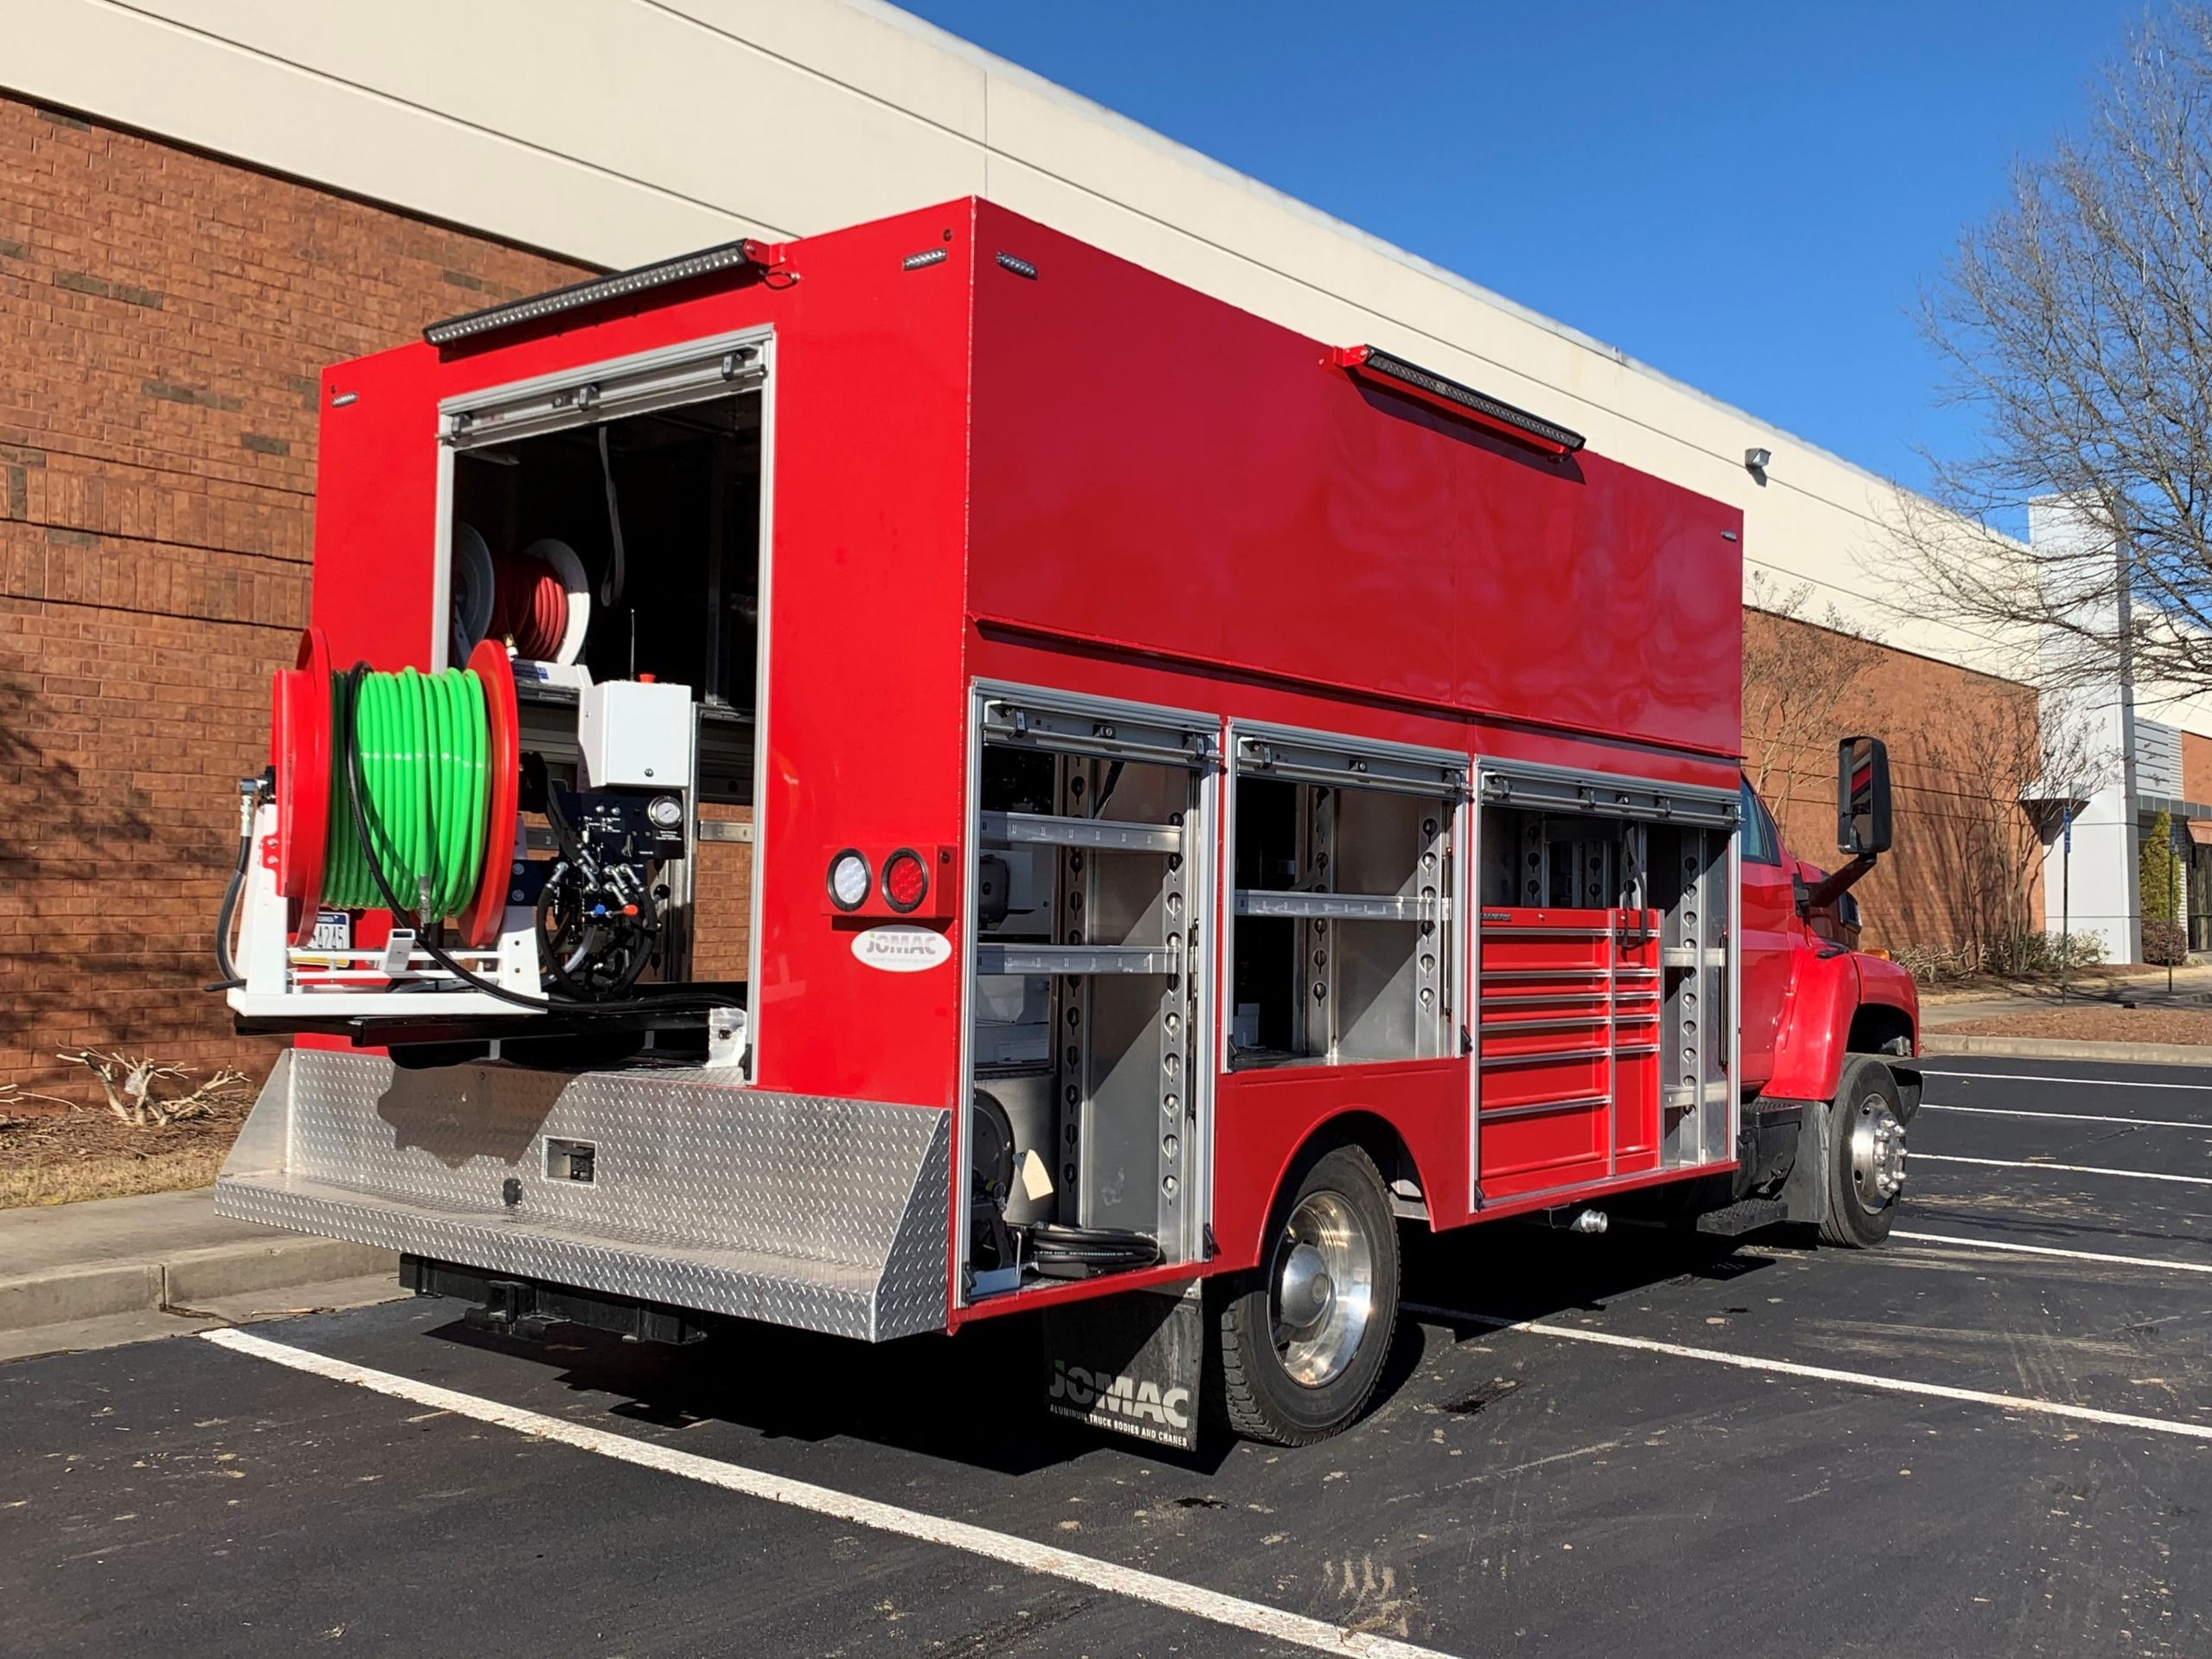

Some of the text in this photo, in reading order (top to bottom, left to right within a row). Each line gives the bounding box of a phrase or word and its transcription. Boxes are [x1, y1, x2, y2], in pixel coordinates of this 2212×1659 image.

[1049, 1359, 1189, 1429] JOMAC
[1049, 1404, 1188, 1448] ALUMINUM TRUCK BODIES AND CRANES
